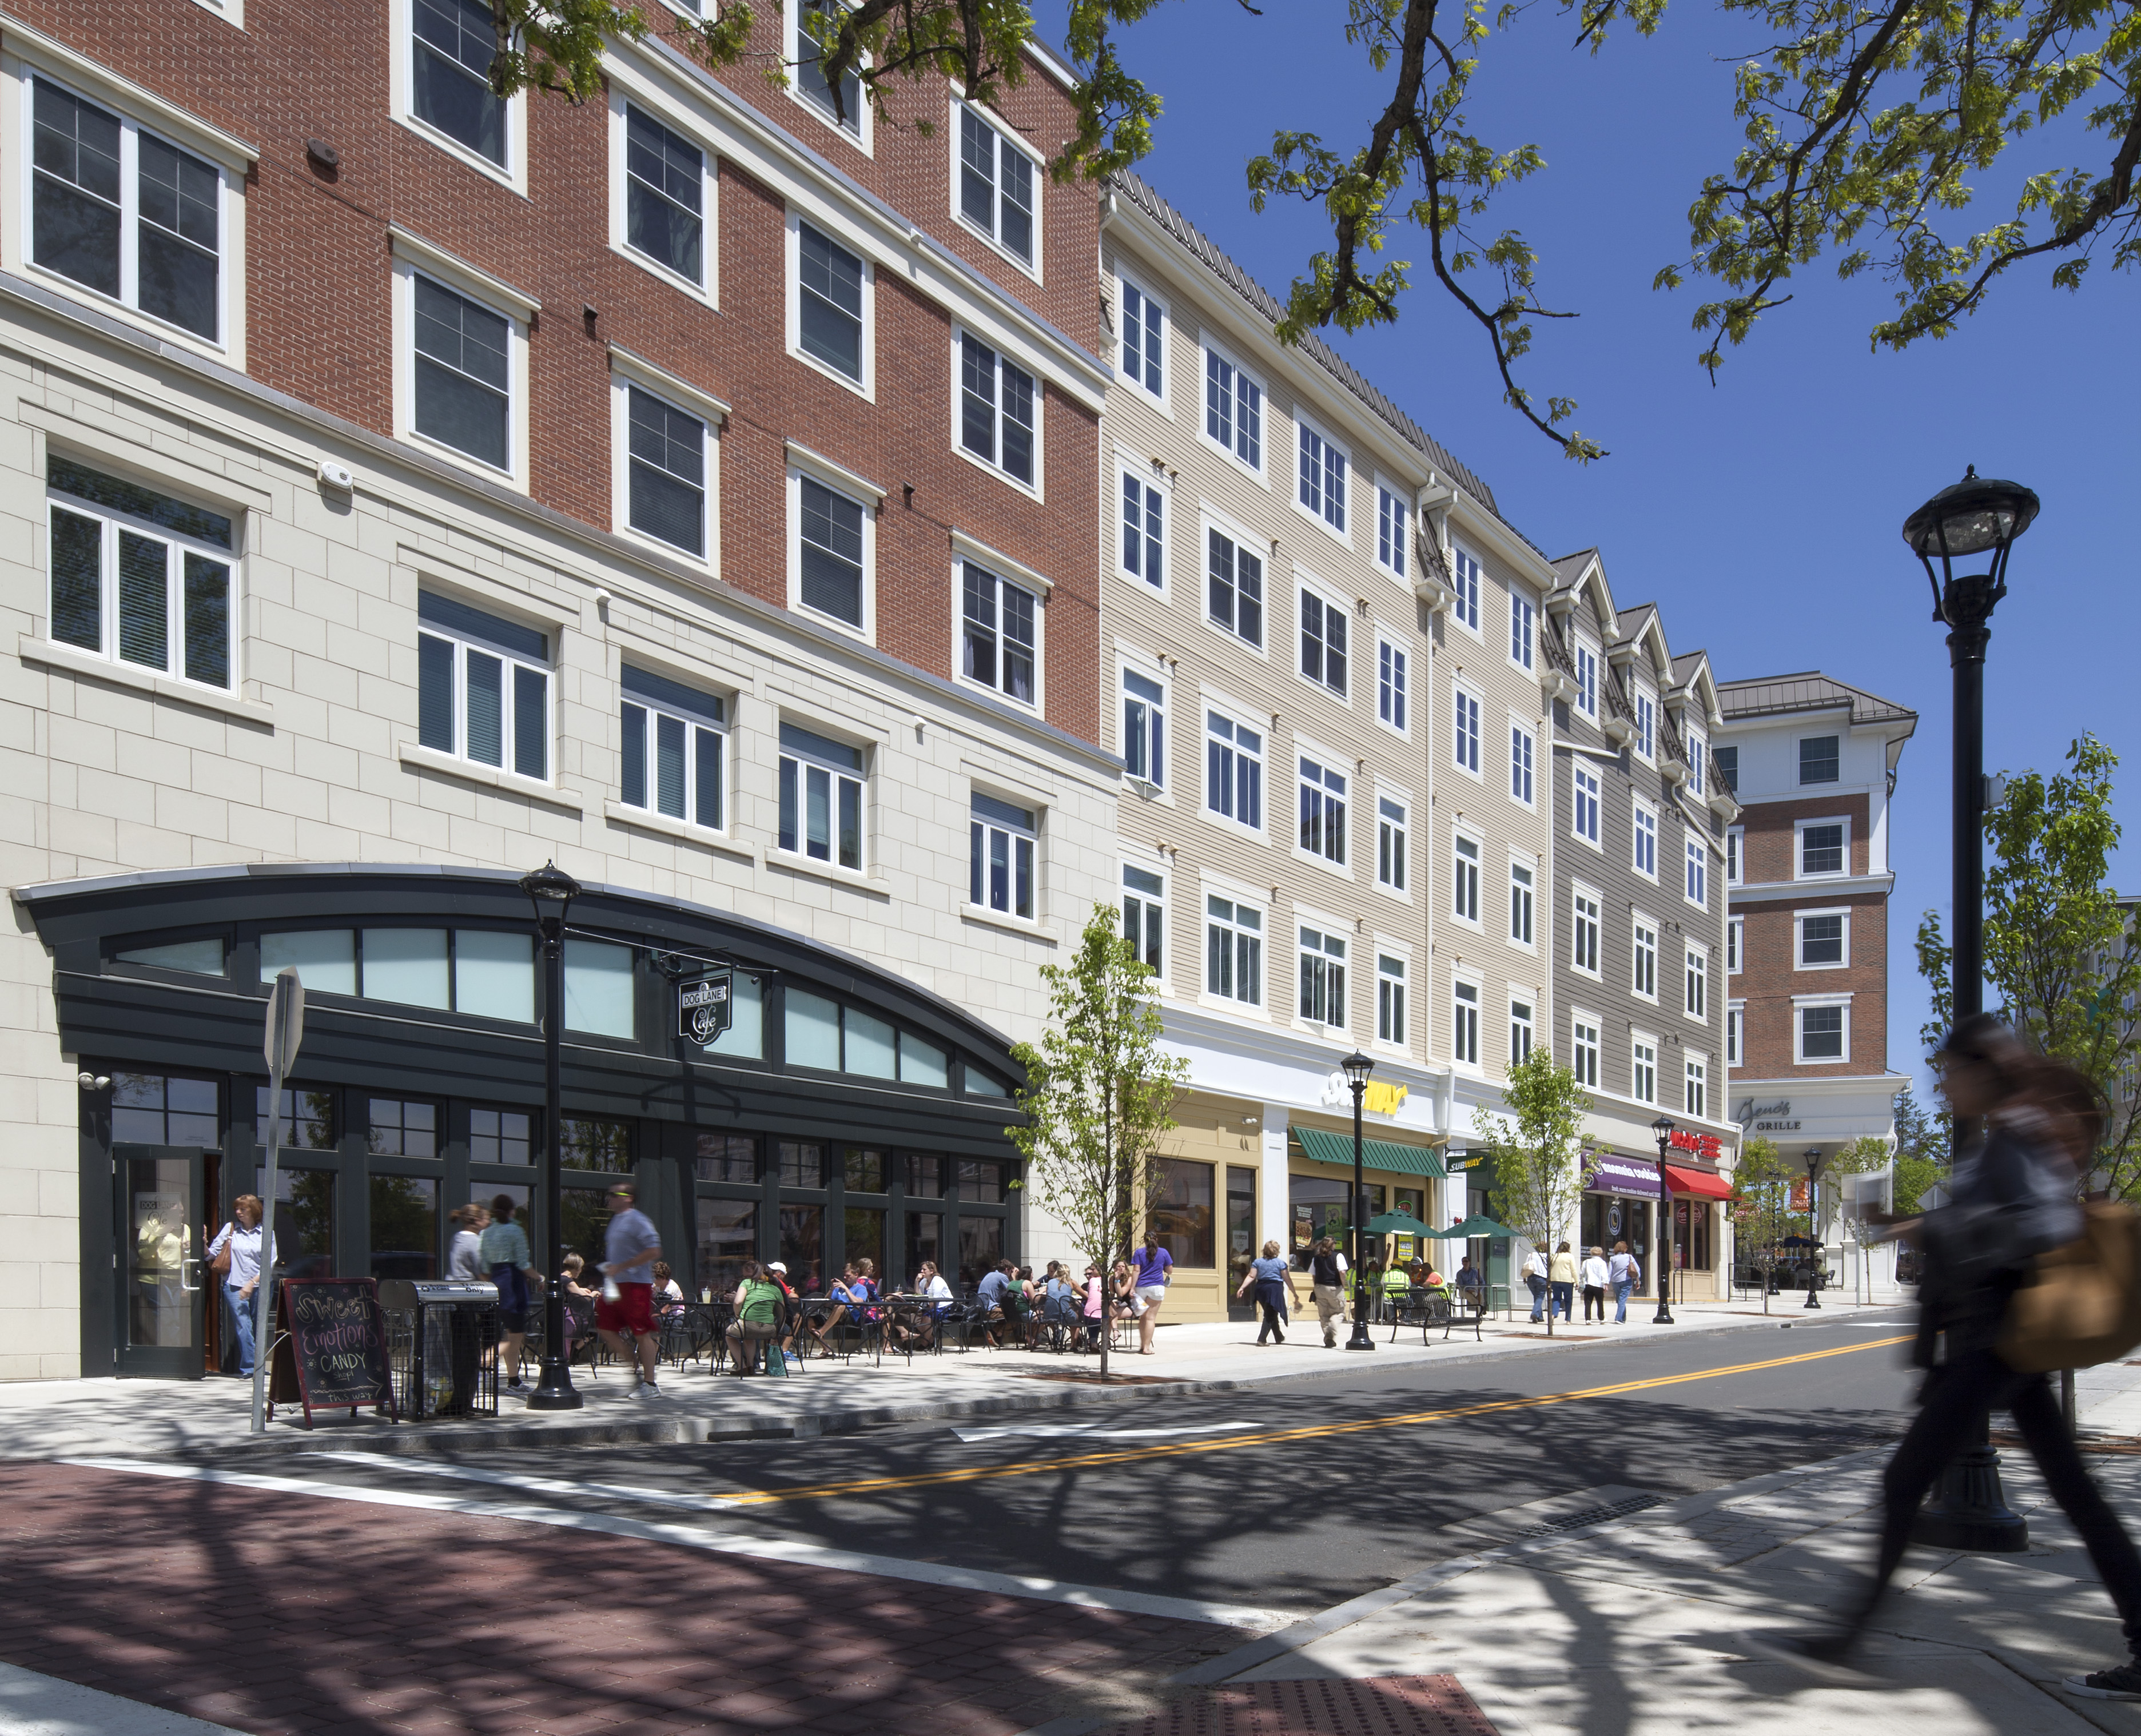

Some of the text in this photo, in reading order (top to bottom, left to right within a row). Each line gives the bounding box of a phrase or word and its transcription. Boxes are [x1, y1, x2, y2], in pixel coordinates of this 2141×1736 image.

[684, 989, 722, 1005] DOG LANE
[1757, 1122, 1801, 1130] GRILLE
[1449, 1156, 1484, 1172] SUBWAY
[296, 1285, 372, 1324] Sweet
[302, 1322, 379, 1355] Emotions
[320, 1353, 366, 1372] CANDY
[328, 1392, 373, 1402] this way
